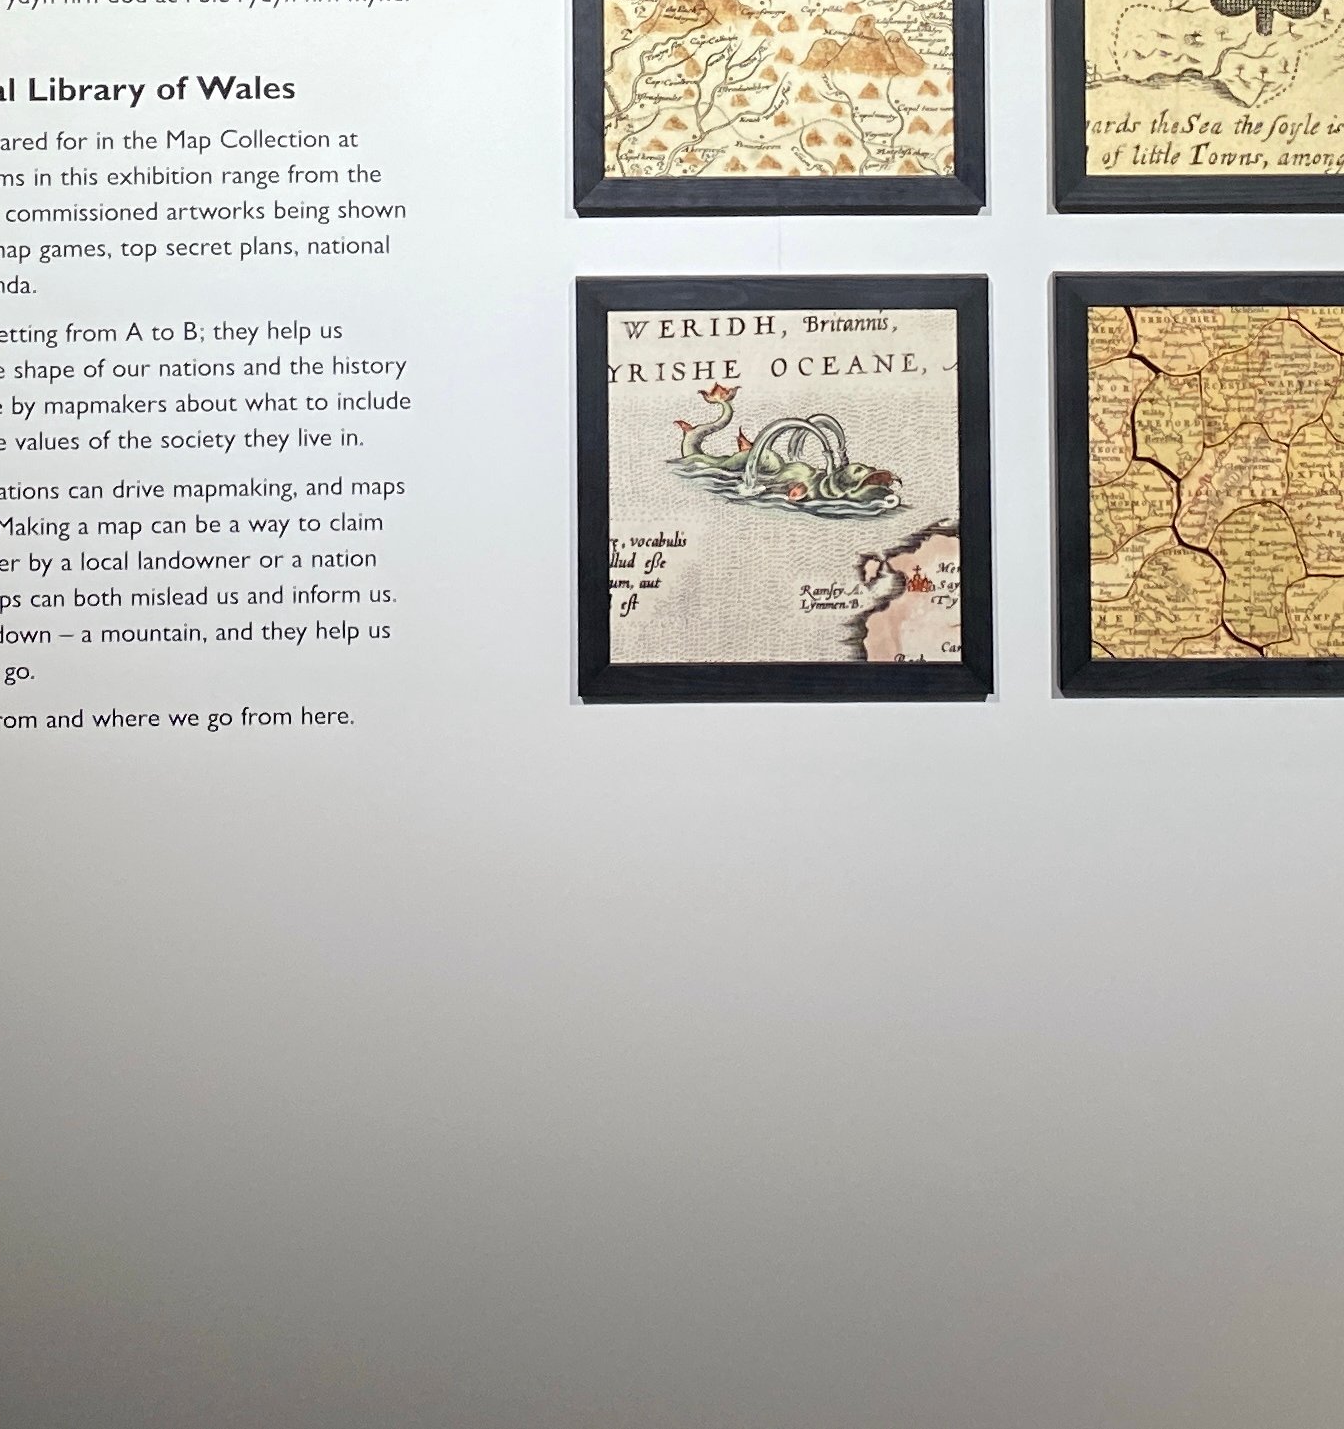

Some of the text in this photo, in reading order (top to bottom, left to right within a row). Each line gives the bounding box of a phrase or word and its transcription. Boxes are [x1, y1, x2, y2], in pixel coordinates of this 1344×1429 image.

[28, 76, 146, 109] Library
[156, 75, 190, 101] of
[195, 75, 296, 101] Wales
[1150, 108, 1180, 135] the
[1180, 112, 1223, 135] Sea
[1233, 114, 1264, 135] the
[55, 130, 89, 151] for
[96, 131, 114, 150] in
[121, 129, 158, 150] the
[166, 129, 212, 156] Map
[220, 128, 330, 149] Collection
[338, 132, 359, 148] at
[1101, 143, 1128, 170] of
[1132, 141, 1181, 166] little
[770, 353, 928, 379] OCEANE,
[68, 485, 103, 500] can
[112, 478, 165, 499] drive
[173, 476, 298, 504] mapmaking,
[305, 475, 343, 497] and
[351, 481, 406, 501] maps
[630, 530, 687, 548] vocabulis
[3, 666, 35, 687] go.
